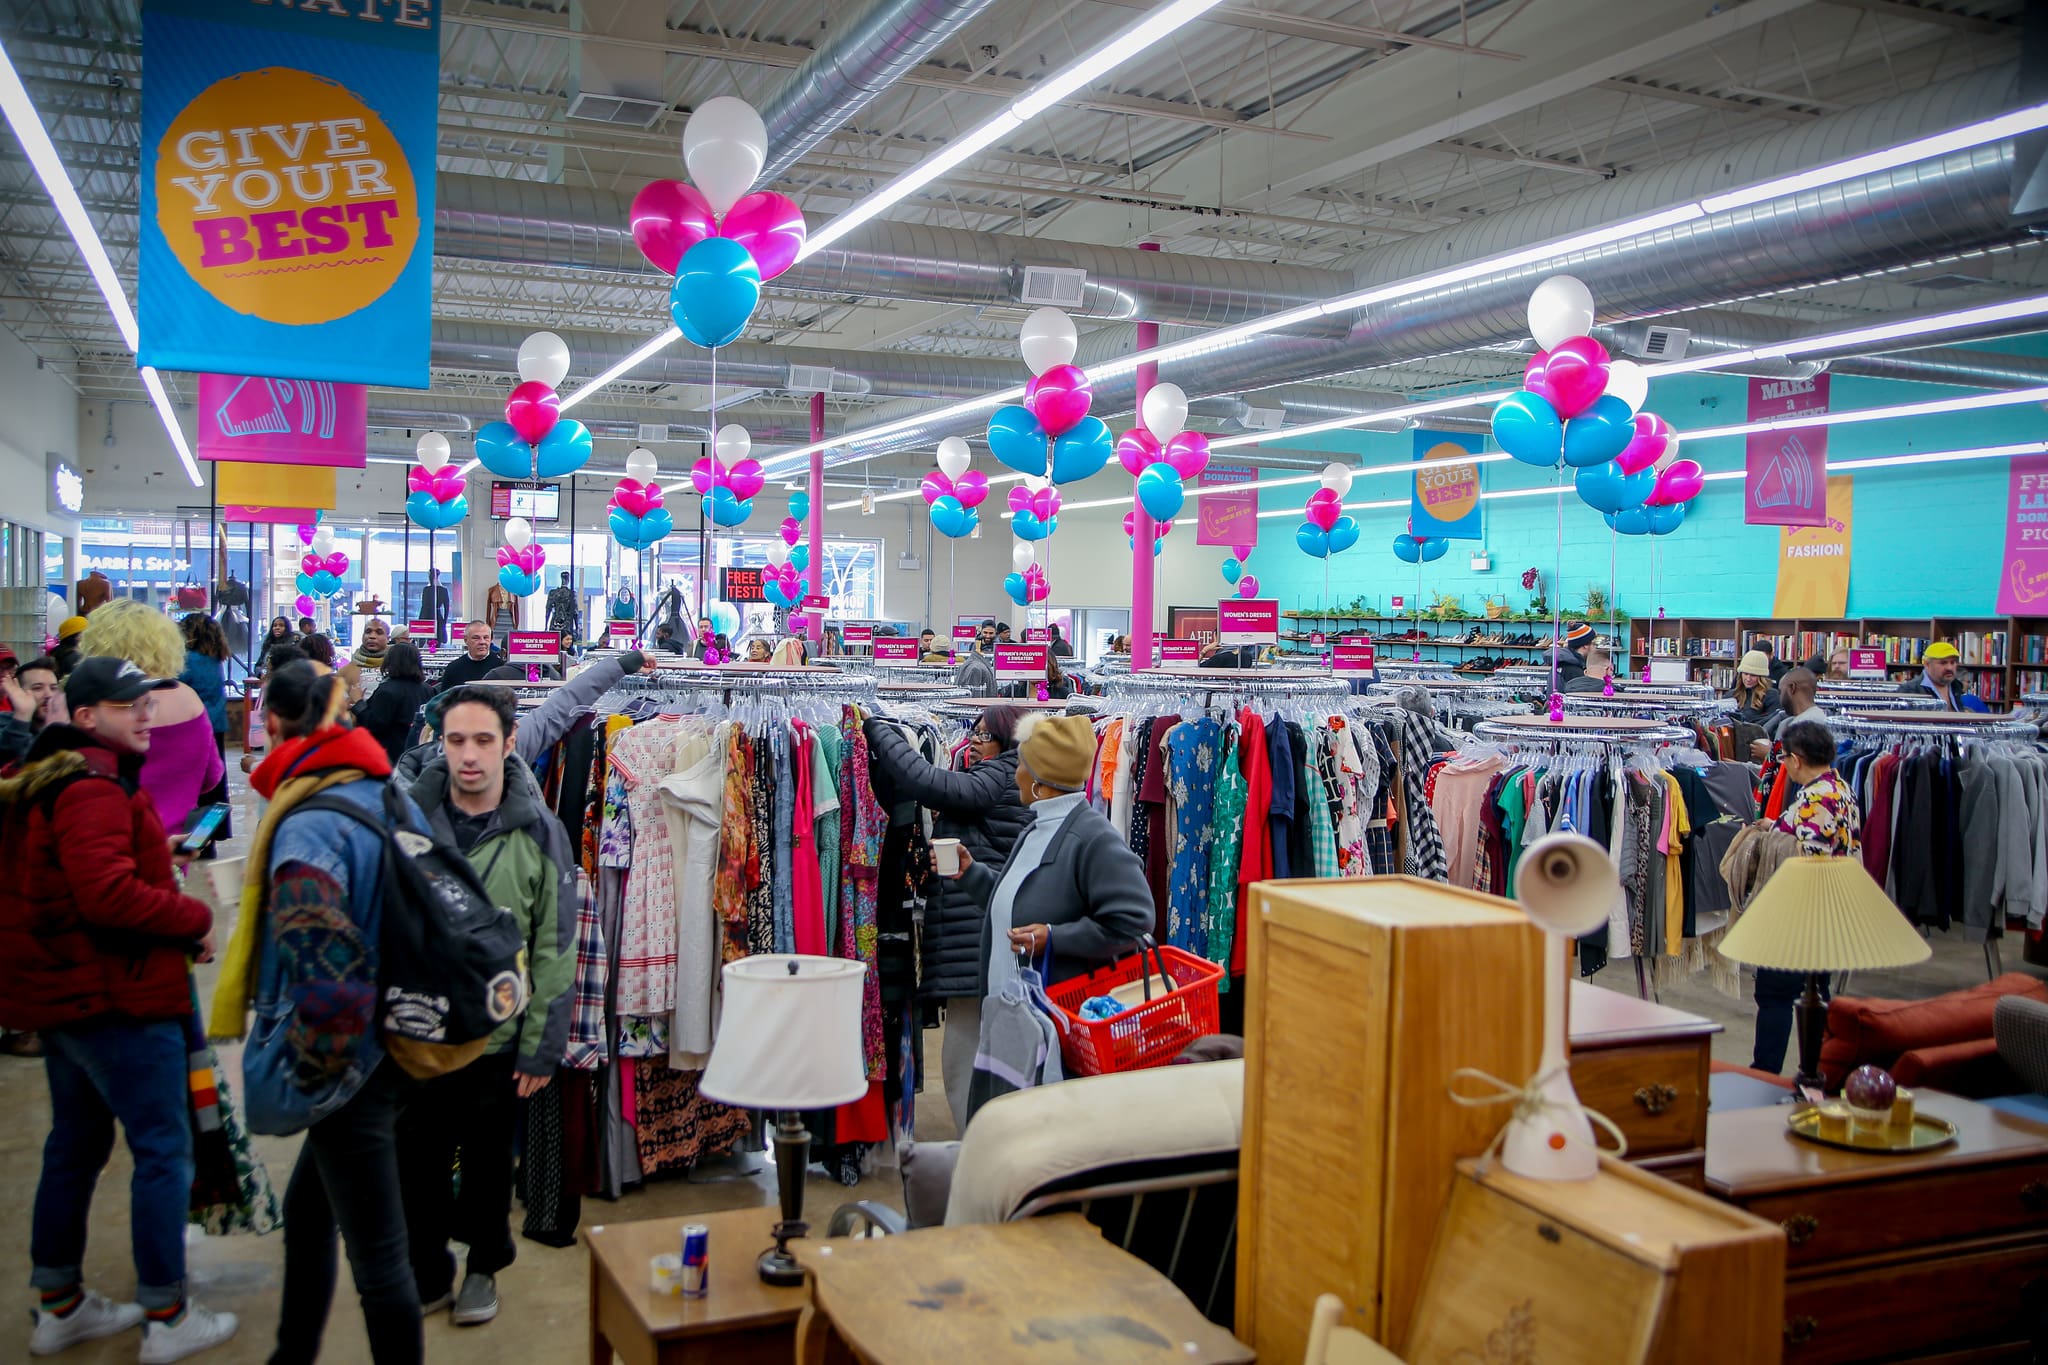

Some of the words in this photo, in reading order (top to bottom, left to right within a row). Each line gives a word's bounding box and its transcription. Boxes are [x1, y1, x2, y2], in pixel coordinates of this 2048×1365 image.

[253, 0, 432, 29] ATE
[177, 118, 371, 171] GIVE
[171, 158, 397, 215] YOUR
[193, 199, 399, 268] BEST
[1761, 377, 1816, 400] MAKE
[1421, 469, 1474, 489] YOUR
[1425, 481, 1475, 505] BEST
[79, 555, 143, 570] BARBER
[1787, 544, 1844, 558] FASHION
[728, 571, 757, 584] FREE
[728, 586, 765, 599] TESTI
